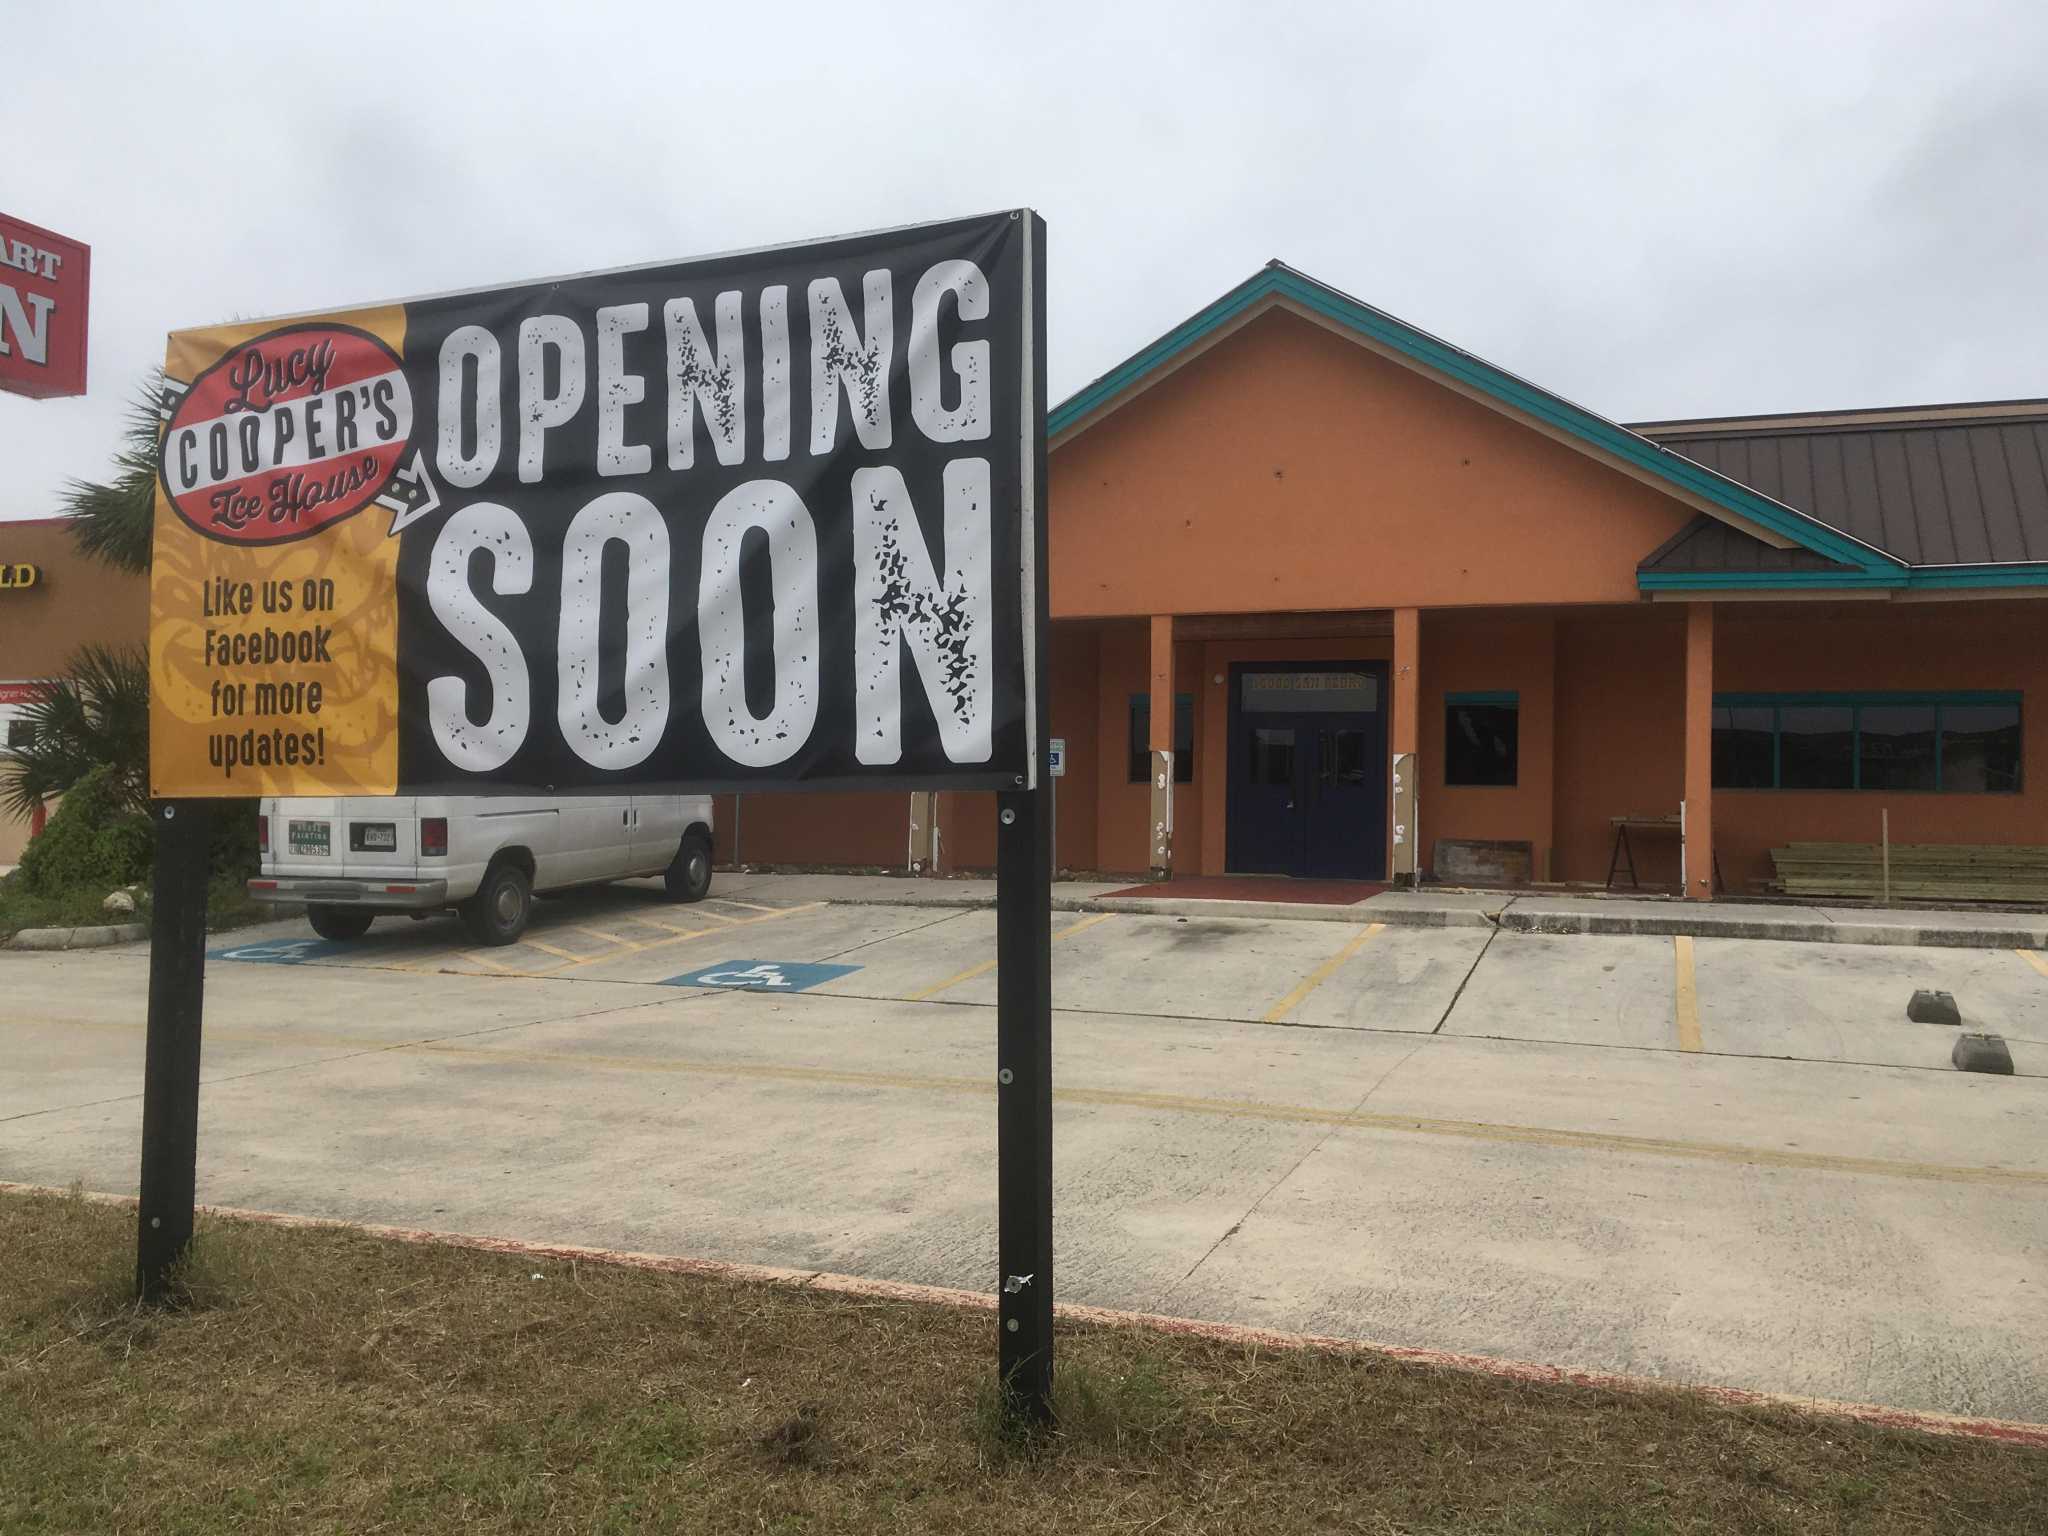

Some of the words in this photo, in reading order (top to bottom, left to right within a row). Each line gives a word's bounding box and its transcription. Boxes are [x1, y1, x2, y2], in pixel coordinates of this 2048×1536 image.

[224, 338, 337, 415] Lucy
[436, 259, 992, 488] OPENING
[179, 378, 399, 489] COOPER'S
[209, 486, 265, 532] Ice
[268, 455, 380, 524] House
[203, 575, 253, 617] Like
[262, 581, 293, 615] us
[302, 577, 335, 612] on
[426, 458, 993, 773] SOON
[204, 625, 332, 667] Facebook
[210, 680, 247, 717] for
[254, 680, 322, 715] more
[208, 727, 325, 779] updates!
